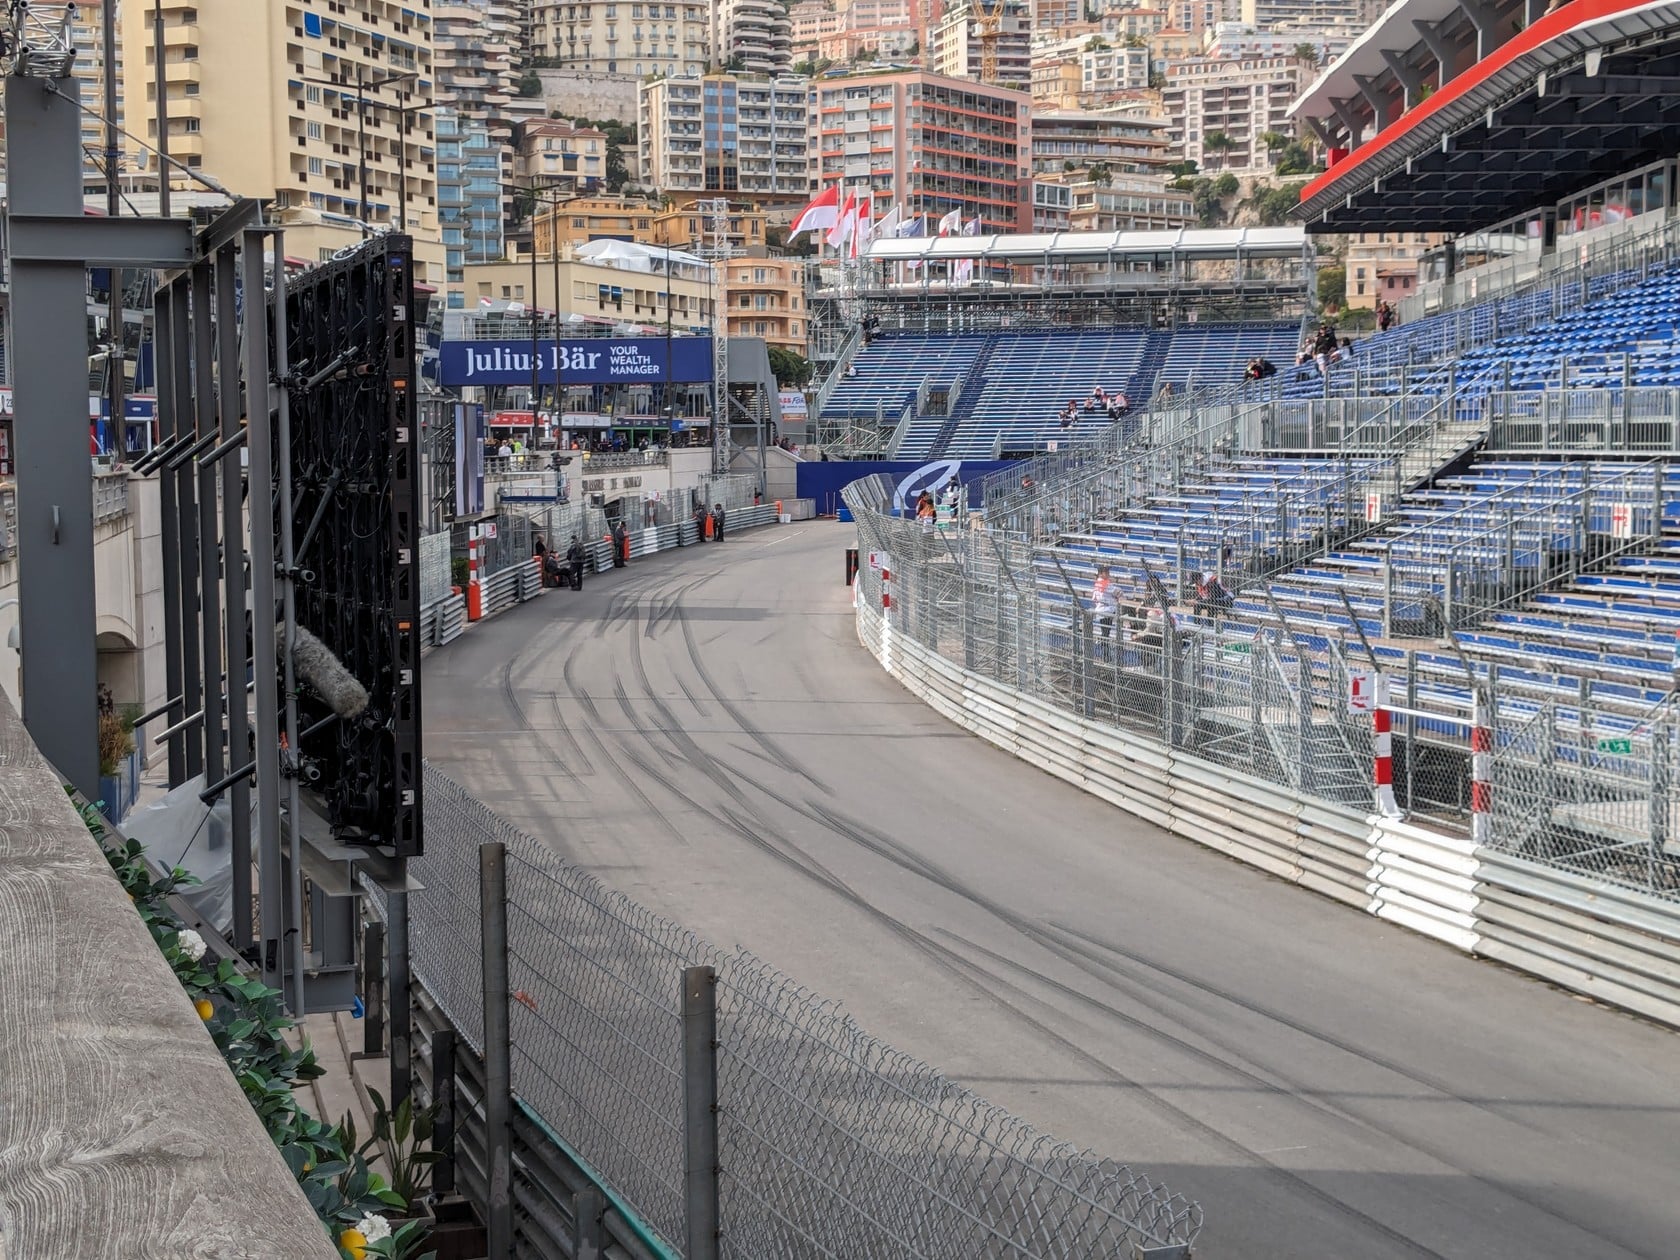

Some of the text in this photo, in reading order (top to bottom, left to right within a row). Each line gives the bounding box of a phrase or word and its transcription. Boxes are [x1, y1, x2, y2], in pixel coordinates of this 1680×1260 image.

[610, 346, 638, 355] YOUR
[466, 347, 602, 376] Julius Bär
[610, 355, 651, 365] WEALTH
[610, 365, 659, 375] MANAGER
